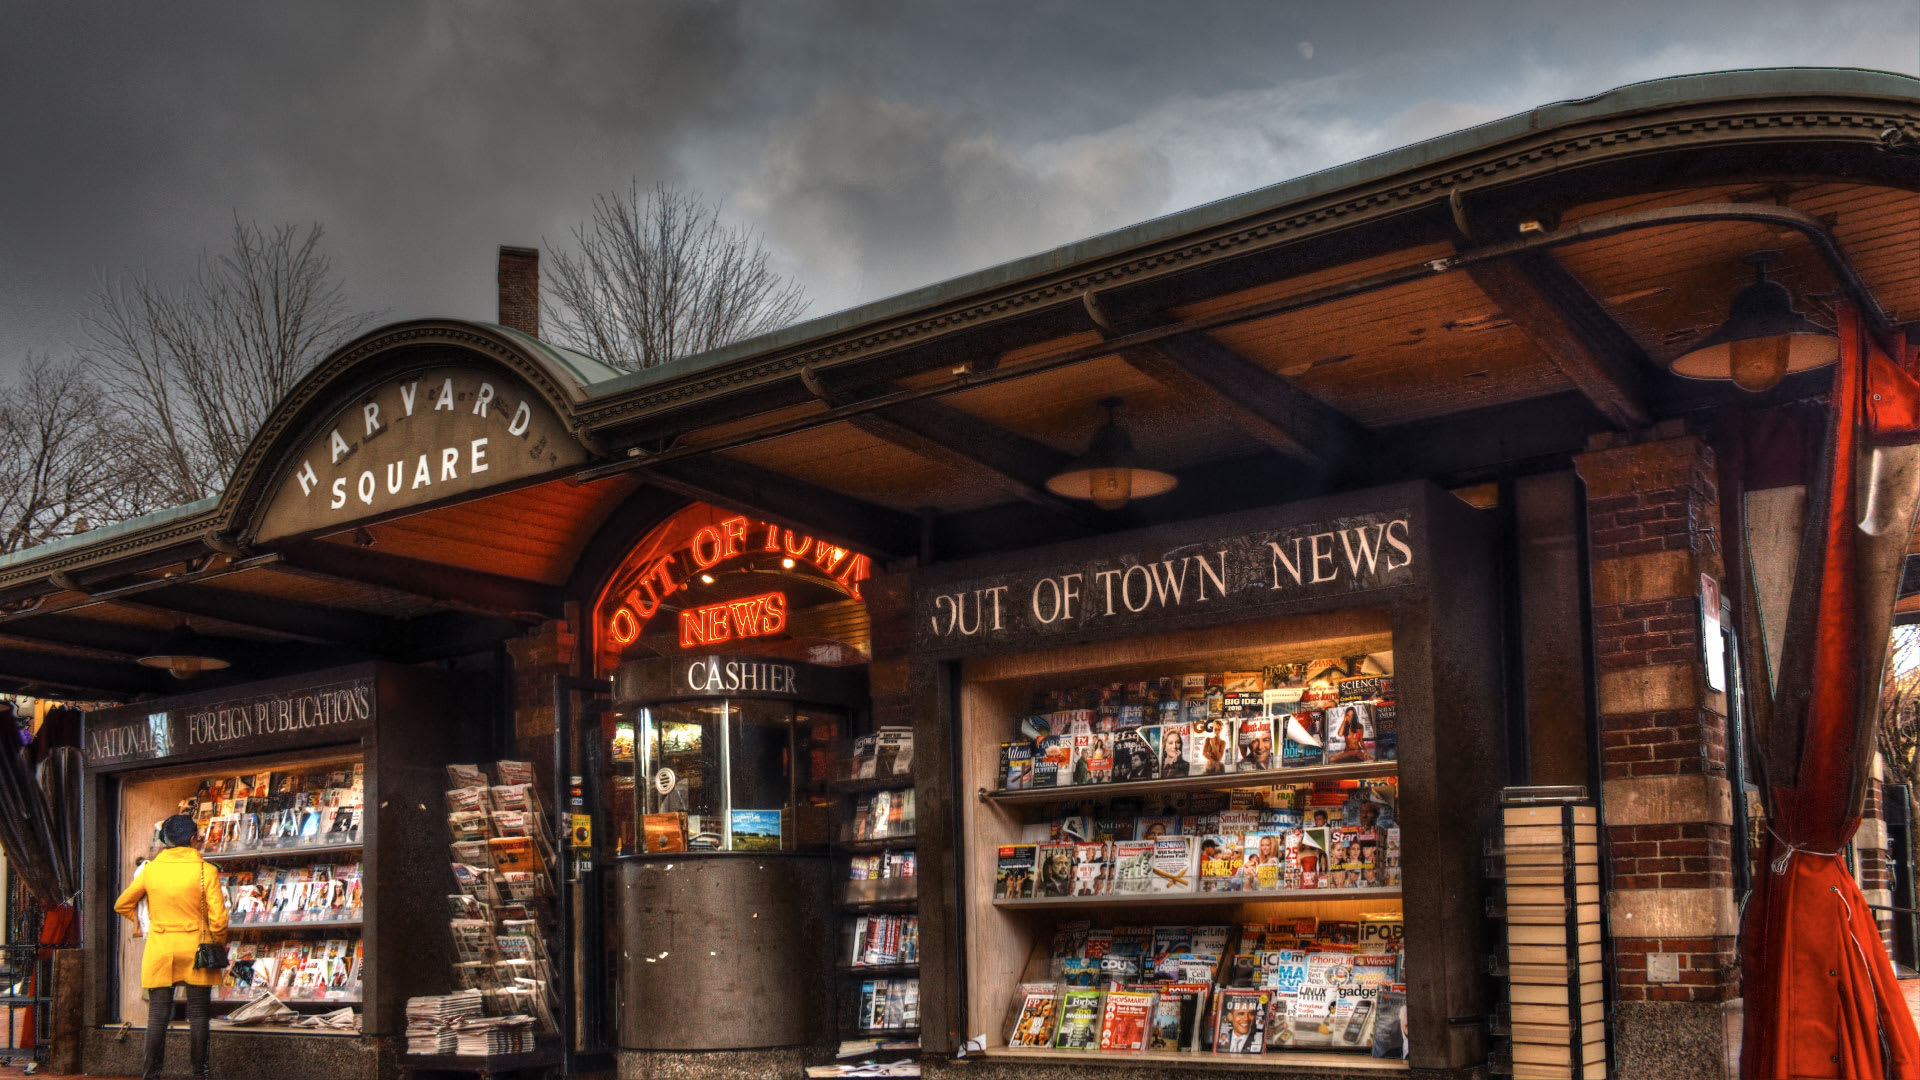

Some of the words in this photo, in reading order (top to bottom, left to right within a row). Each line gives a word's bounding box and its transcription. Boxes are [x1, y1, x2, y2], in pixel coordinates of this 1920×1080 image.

[296, 378, 531, 497] HARVARD
[331, 438, 489, 510] SQUARE
[1032, 573, 1085, 624] OF
[1095, 550, 1228, 616] TOWN
[1267, 519, 1413, 589] NEWS
[610, 554, 677, 644] OUT
[691, 515, 748, 568] OF
[681, 592, 786, 648] NEWS
[687, 661, 798, 694] CASHIER
[1341, 678, 1380, 690] SCIENCE
[91, 722, 159, 760] NATIONAL
[189, 706, 252, 746] FOREIGN
[256, 685, 370, 736] PUBLICATIONS
[1259, 811, 1302, 826] Money
[1331, 831, 1357, 842] Star
[1101, 959, 1127, 972] CPU
[1192, 970, 1206, 978] Cell
[1298, 986, 1327, 997] LINUX
[1027, 999, 1040, 1007] FP
[1072, 997, 1098, 1007] Forbes
[1226, 1001, 1263, 1010] OBAMA
